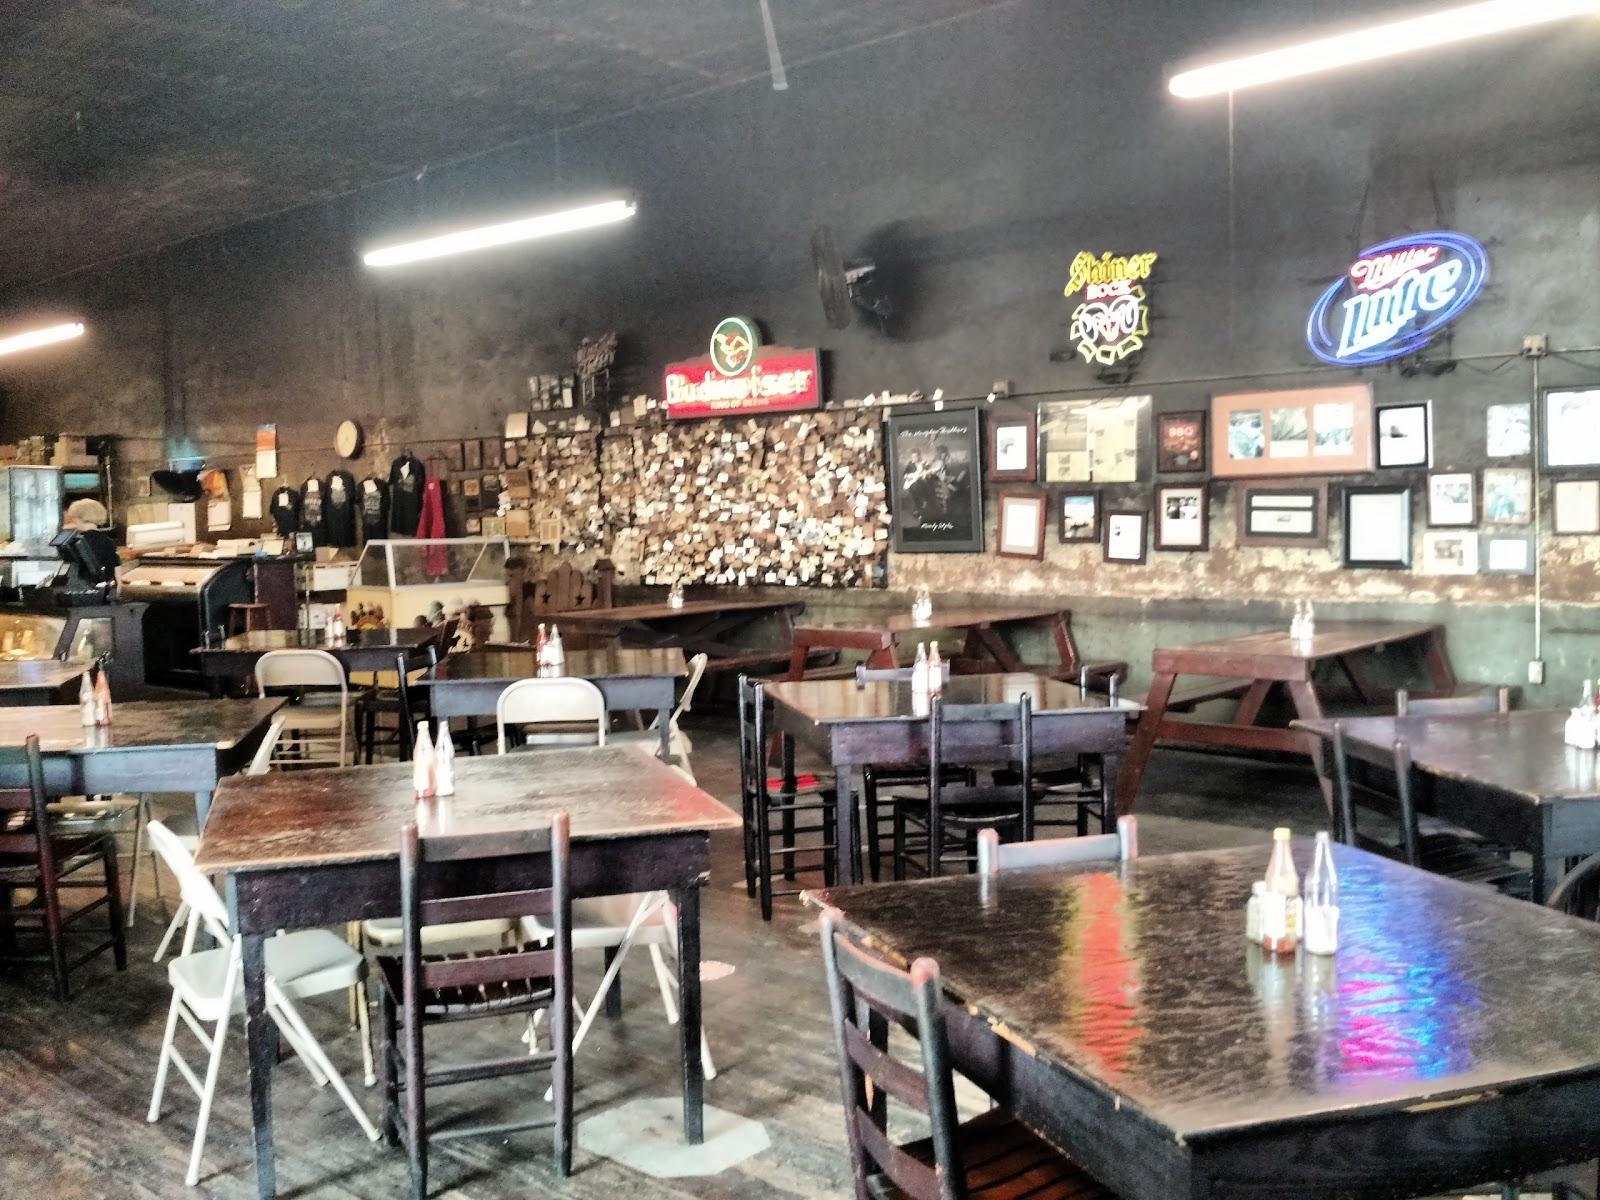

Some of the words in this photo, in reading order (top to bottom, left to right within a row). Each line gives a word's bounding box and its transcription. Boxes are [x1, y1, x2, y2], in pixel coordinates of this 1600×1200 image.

[1064, 250, 1158, 298] Shiner
[1336, 258, 1463, 358] Lite
[665, 364, 813, 405] Budweiser
